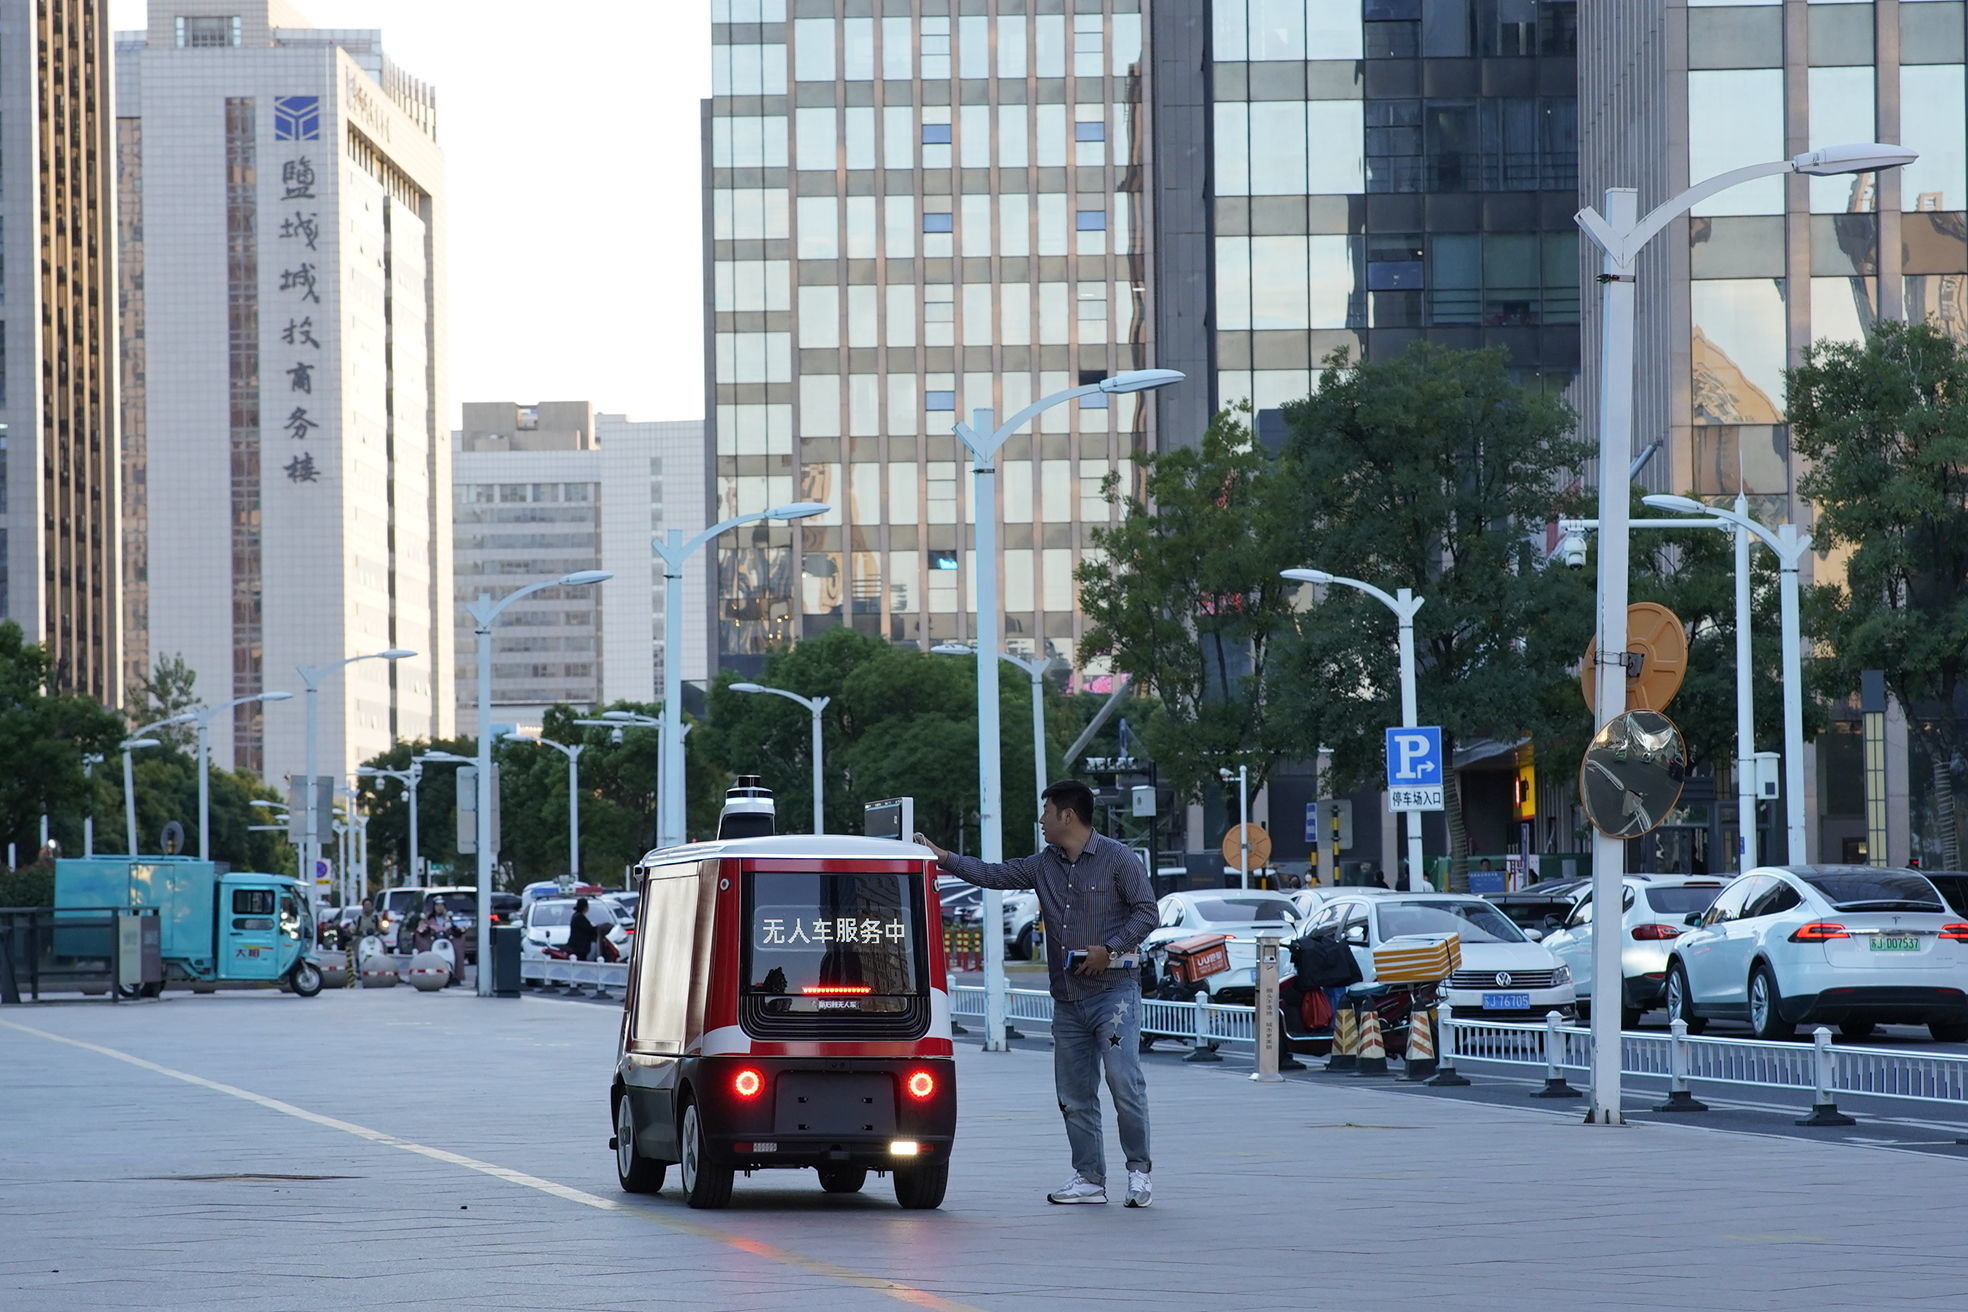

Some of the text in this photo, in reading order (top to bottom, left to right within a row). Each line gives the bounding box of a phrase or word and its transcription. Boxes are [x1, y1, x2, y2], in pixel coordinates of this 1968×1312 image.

[1394, 735, 1430, 779] P
[1392, 791, 1441, 807] 停车场入口
[762, 917, 905, 944] 无人车服务中
